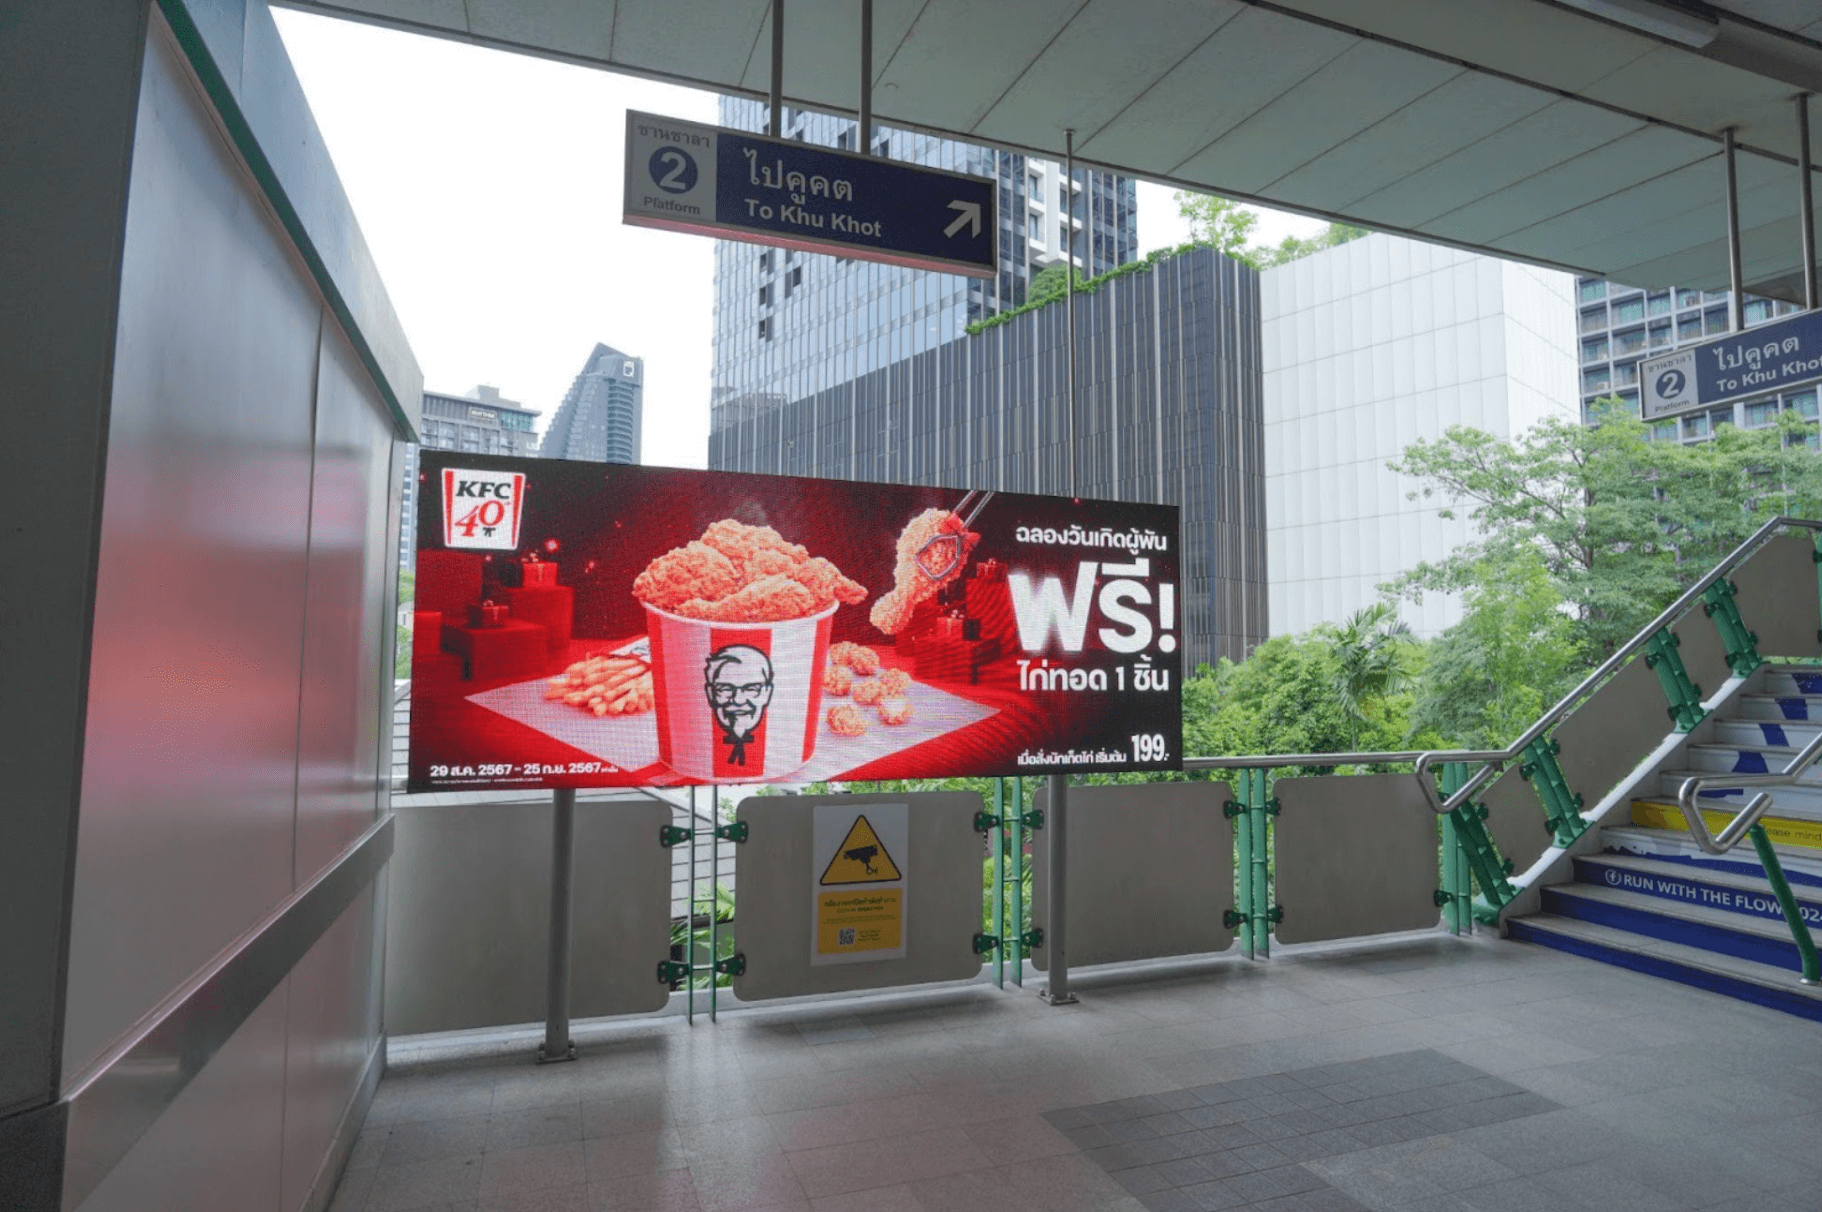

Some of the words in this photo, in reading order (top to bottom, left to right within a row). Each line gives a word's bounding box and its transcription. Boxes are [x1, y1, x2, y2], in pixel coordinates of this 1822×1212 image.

[638, 125, 709, 147] ชานชาลา
[659, 151, 687, 190] 2
[742, 147, 853, 205] ไปคูคต
[643, 196, 700, 214] Platform
[744, 198, 773, 219] To
[780, 204, 823, 228] Khu
[831, 212, 881, 237] Khot
[1712, 336, 1799, 371] ไปคูคต
[1662, 372, 1680, 397] 2
[1716, 378, 1738, 392] To
[1742, 369, 1776, 386] Khu
[1655, 400, 1690, 412] Platform
[455, 480, 512, 499] KFC
[454, 500, 505, 537] 40
[1016, 524, 1168, 555] ฉลองวันเกิดผู้พัน
[1007, 557, 1176, 655] ฟรี!
[1016, 659, 1108, 692] ไก่ทอด
[1116, 666, 1125, 691] 1
[1134, 654, 1170, 692] ชิ้น
[430, 764, 449, 777] 29
[450, 765, 475, 776] ส.ค.
[478, 763, 512, 776] 2567
[523, 763, 540, 775] 25
[542, 764, 566, 774] ก.ย.
[568, 762, 601, 774] 2567
[1624, 874, 1654, 891] RUN
[1657, 880, 1697, 899] WITH
[1700, 888, 1731, 906] THE
[1735, 895, 1783, 915] FLOW
